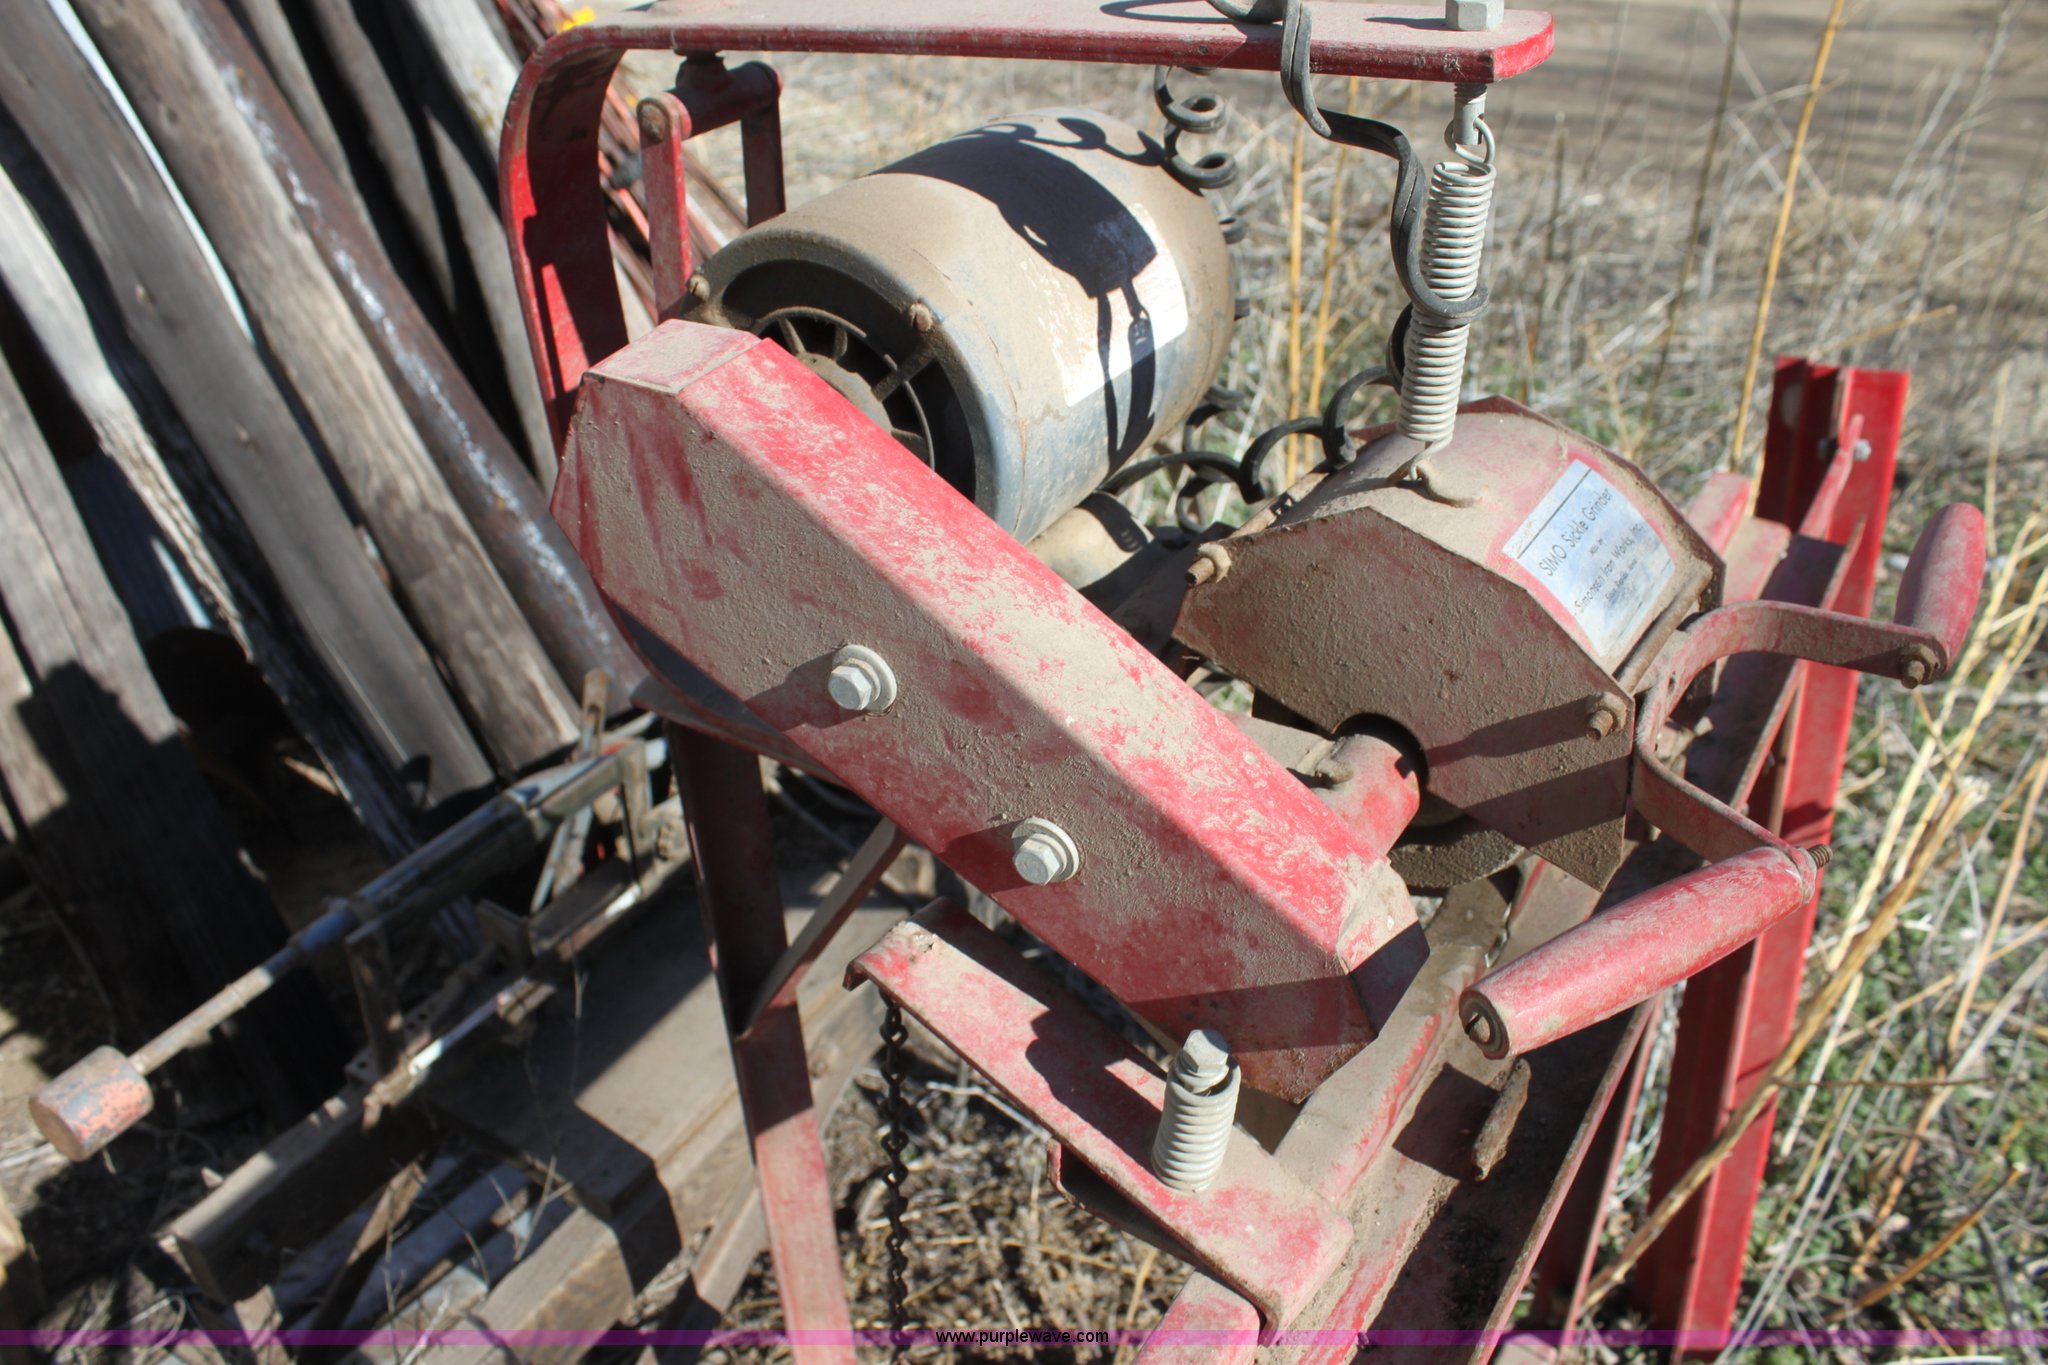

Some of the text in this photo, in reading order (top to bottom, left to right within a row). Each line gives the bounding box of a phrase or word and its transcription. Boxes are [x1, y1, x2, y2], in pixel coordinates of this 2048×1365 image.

[1538, 544, 1567, 577] SIMO
[1561, 519, 1589, 548] Sickle
[1582, 487, 1611, 521] Grinder
[1574, 575, 1605, 613] Simonsen
[1600, 559, 1616, 578] Iron
